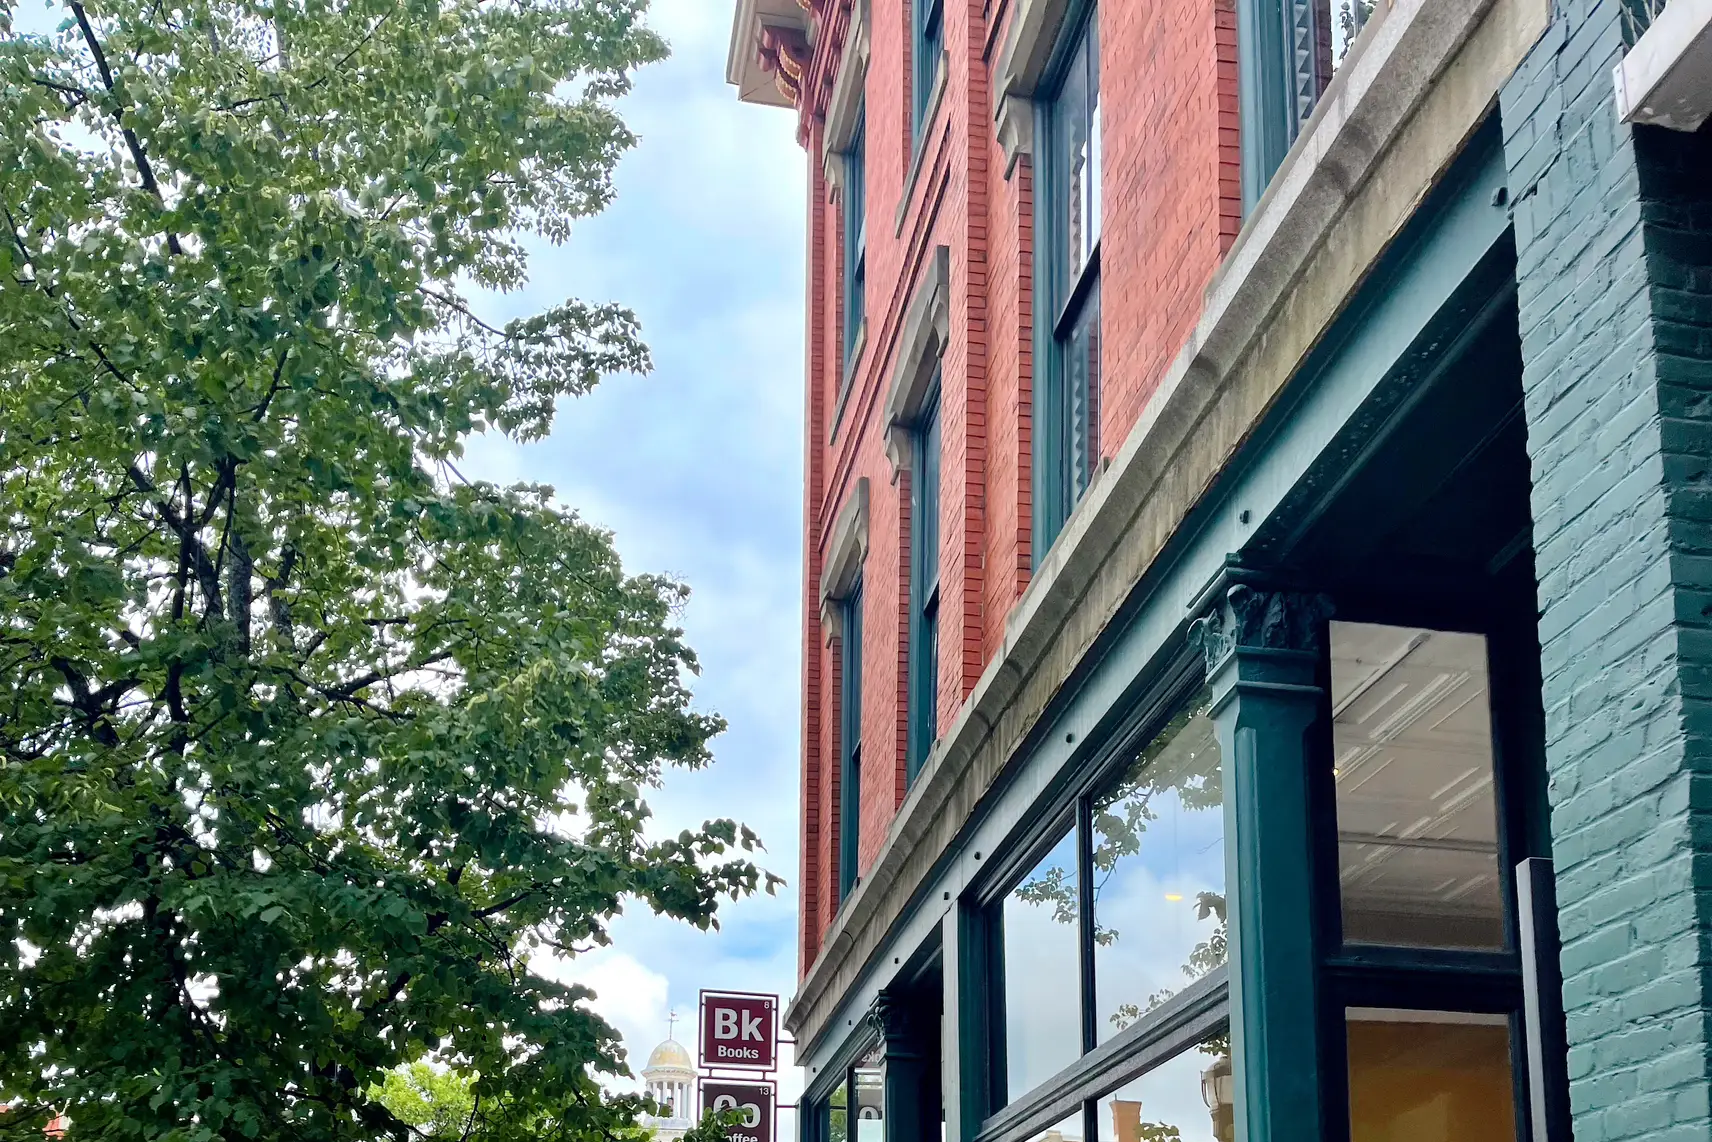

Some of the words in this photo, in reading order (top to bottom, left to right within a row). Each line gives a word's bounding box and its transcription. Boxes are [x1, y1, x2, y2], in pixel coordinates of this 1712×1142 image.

[763, 1001, 770, 1009] 8
[714, 1007, 764, 1042] Bk
[717, 1045, 759, 1059] Books
[759, 1087, 769, 1096] 13
